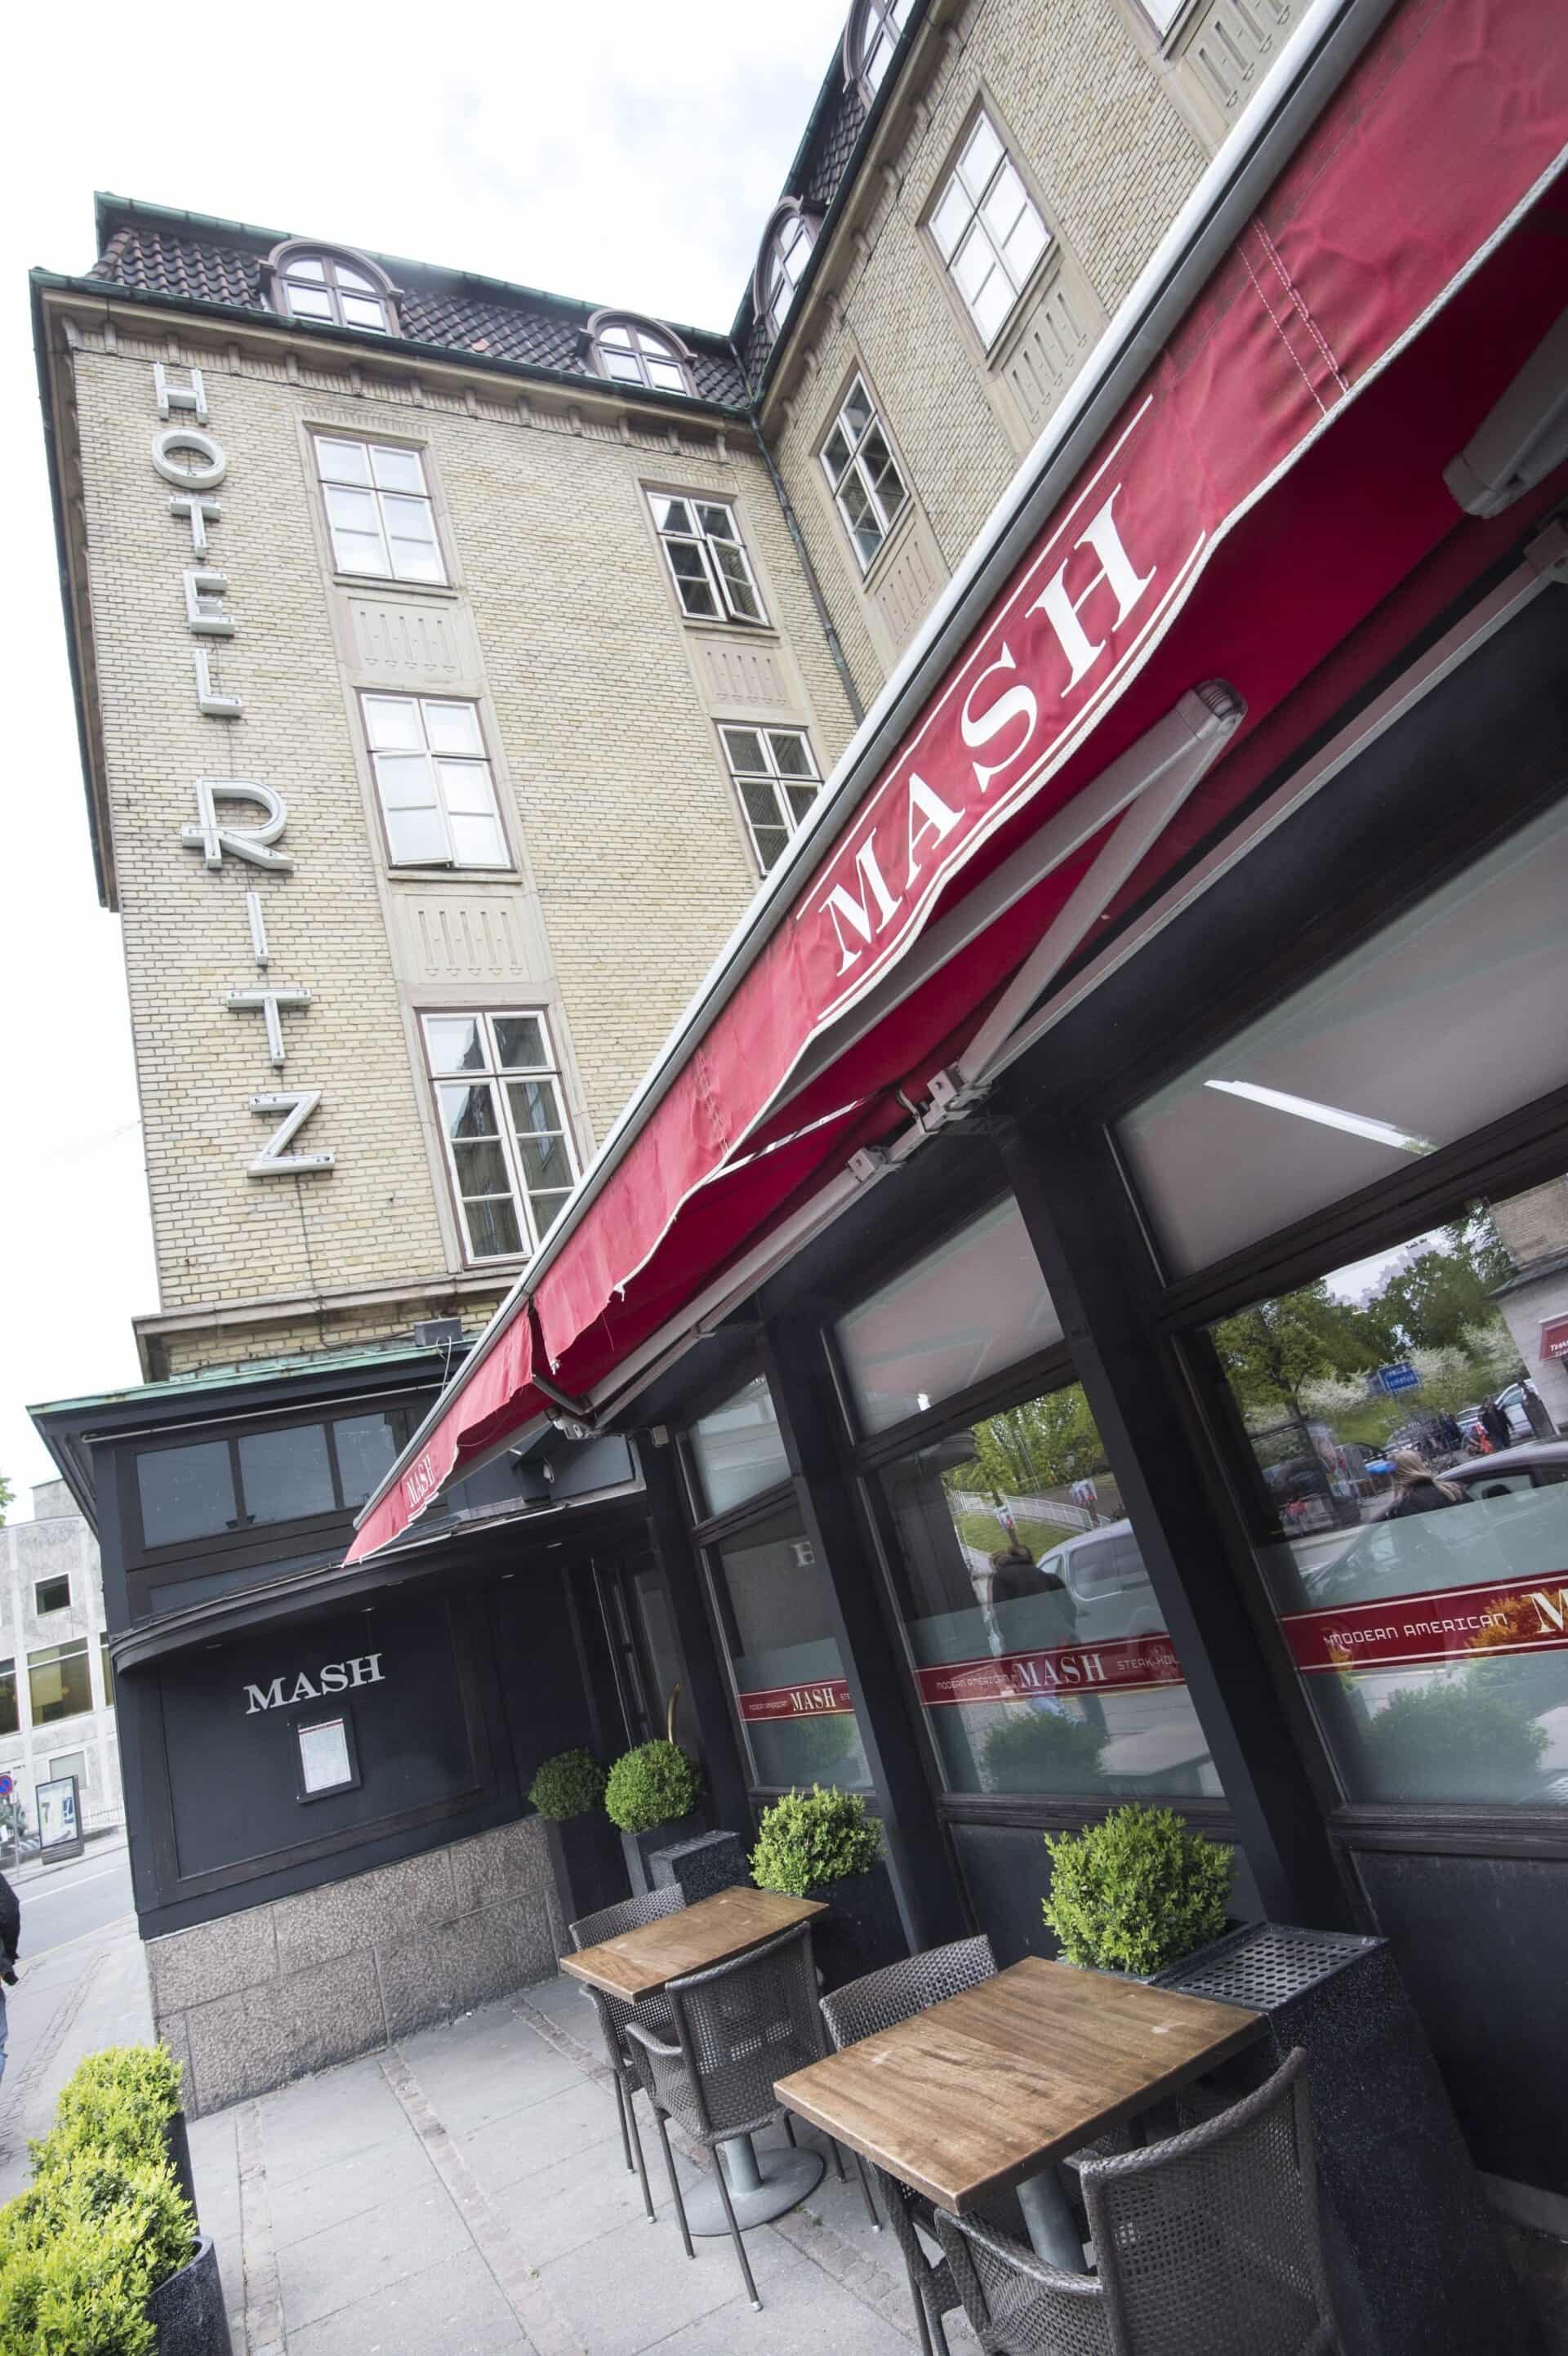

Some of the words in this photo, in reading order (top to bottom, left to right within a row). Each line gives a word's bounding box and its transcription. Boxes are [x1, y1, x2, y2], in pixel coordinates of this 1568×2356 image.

[151, 361, 243, 718] HOTEL
[817, 482, 1157, 978] MASH
[181, 776, 336, 1178] RITZ
[1329, 1626, 1399, 1646] MODERN
[1403, 1612, 1508, 1638] AMERICAN
[243, 1652, 386, 1715] MASH
[791, 1687, 837, 1712] MASH
[1015, 1652, 1108, 1688] MASH
